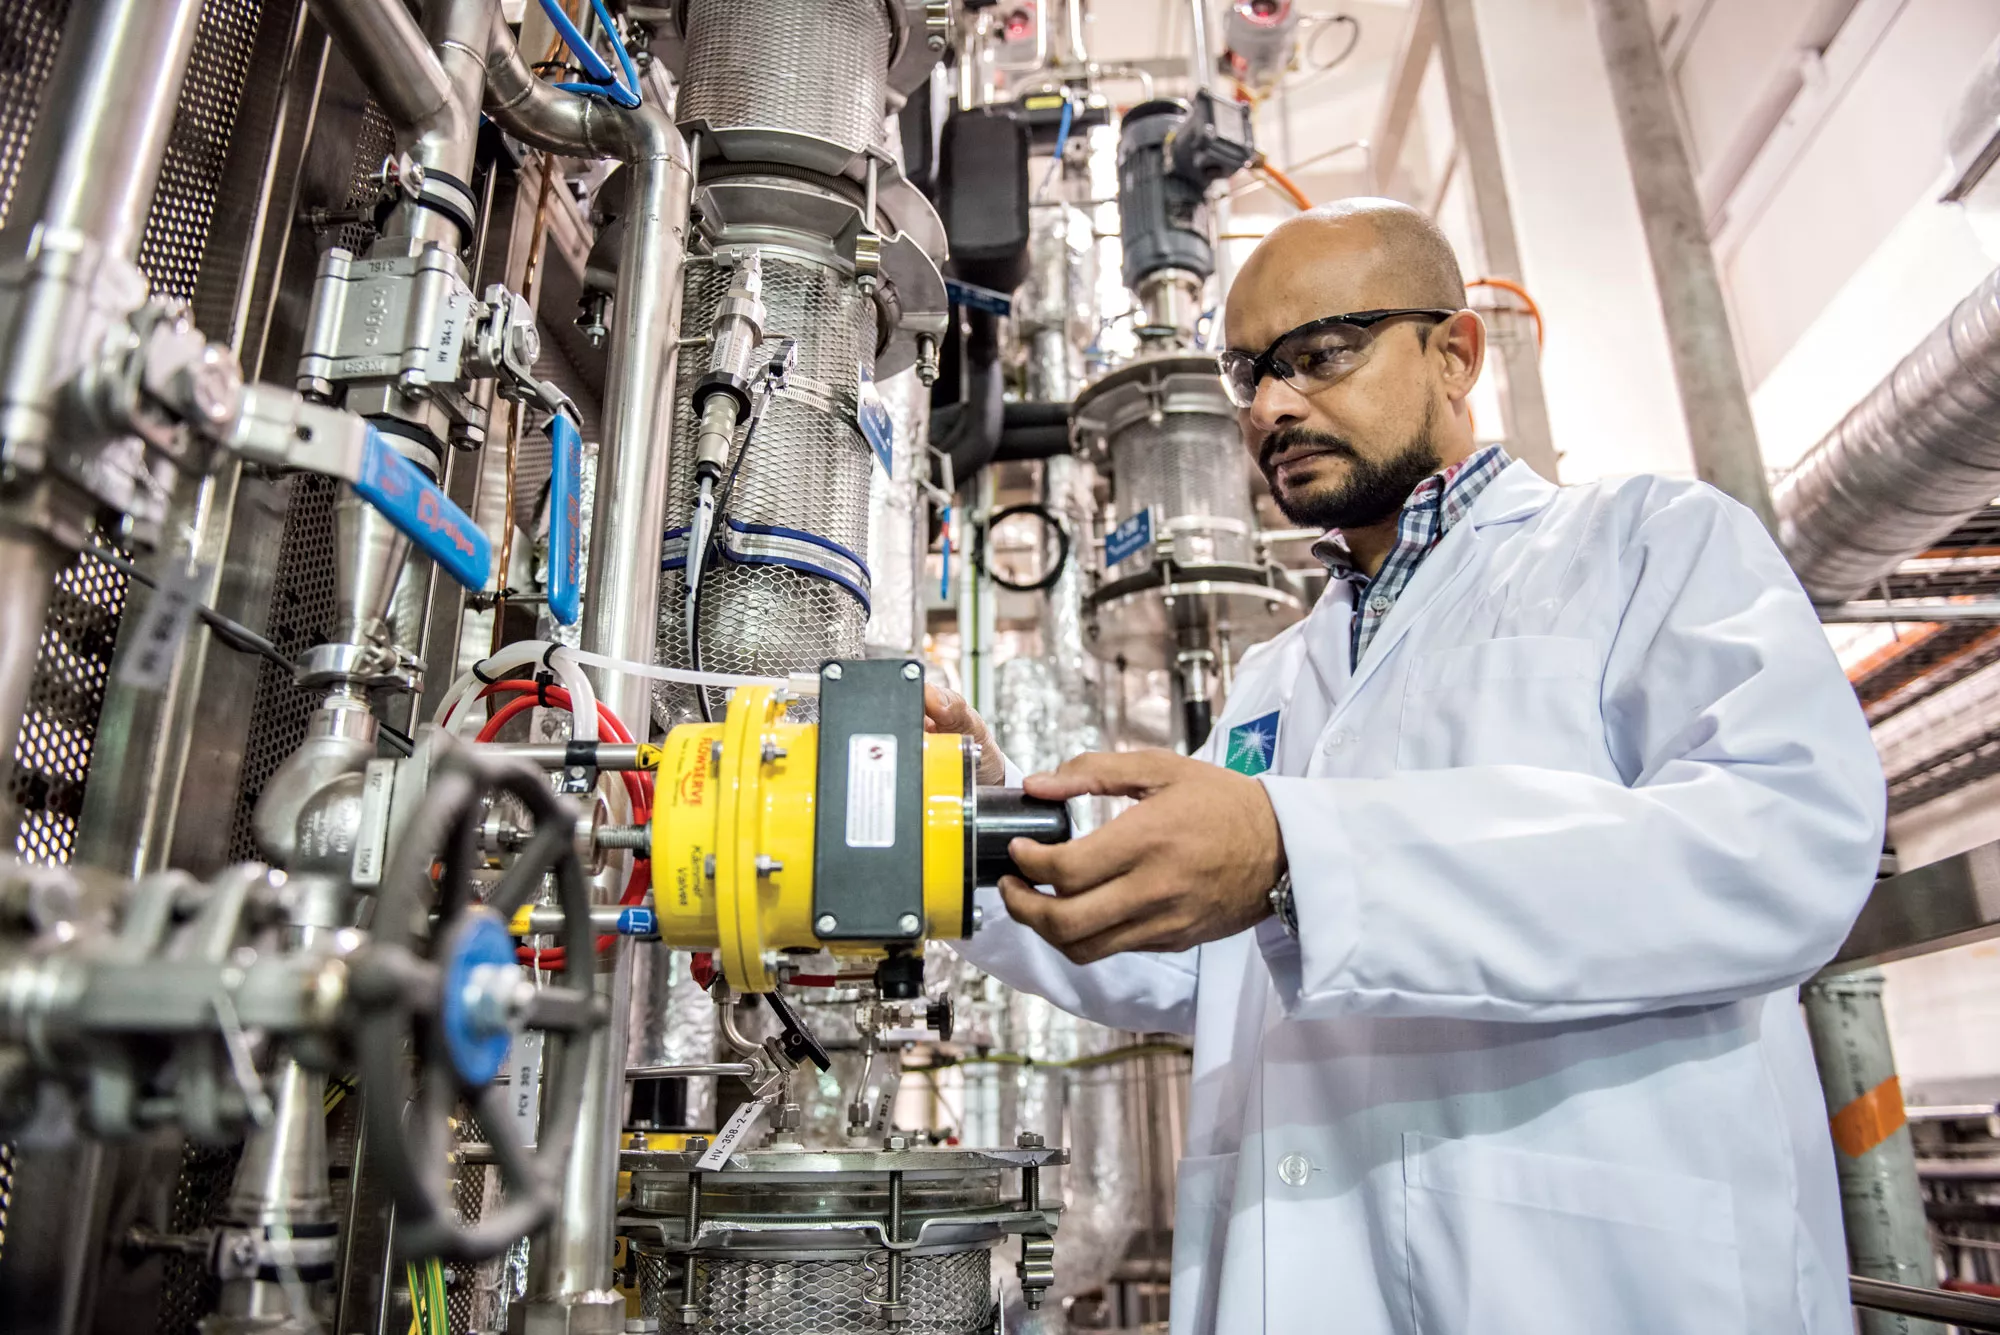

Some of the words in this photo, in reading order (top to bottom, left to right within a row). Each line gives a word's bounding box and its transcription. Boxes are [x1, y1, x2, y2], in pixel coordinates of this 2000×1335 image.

[437, 350, 448, 362] HV
[689, 737, 713, 807] FLOWSERVE
[517, 1093, 529, 1117] PCV
[876, 1120, 884, 1131] HV
[708, 1118, 747, 1161] HV-358-2
